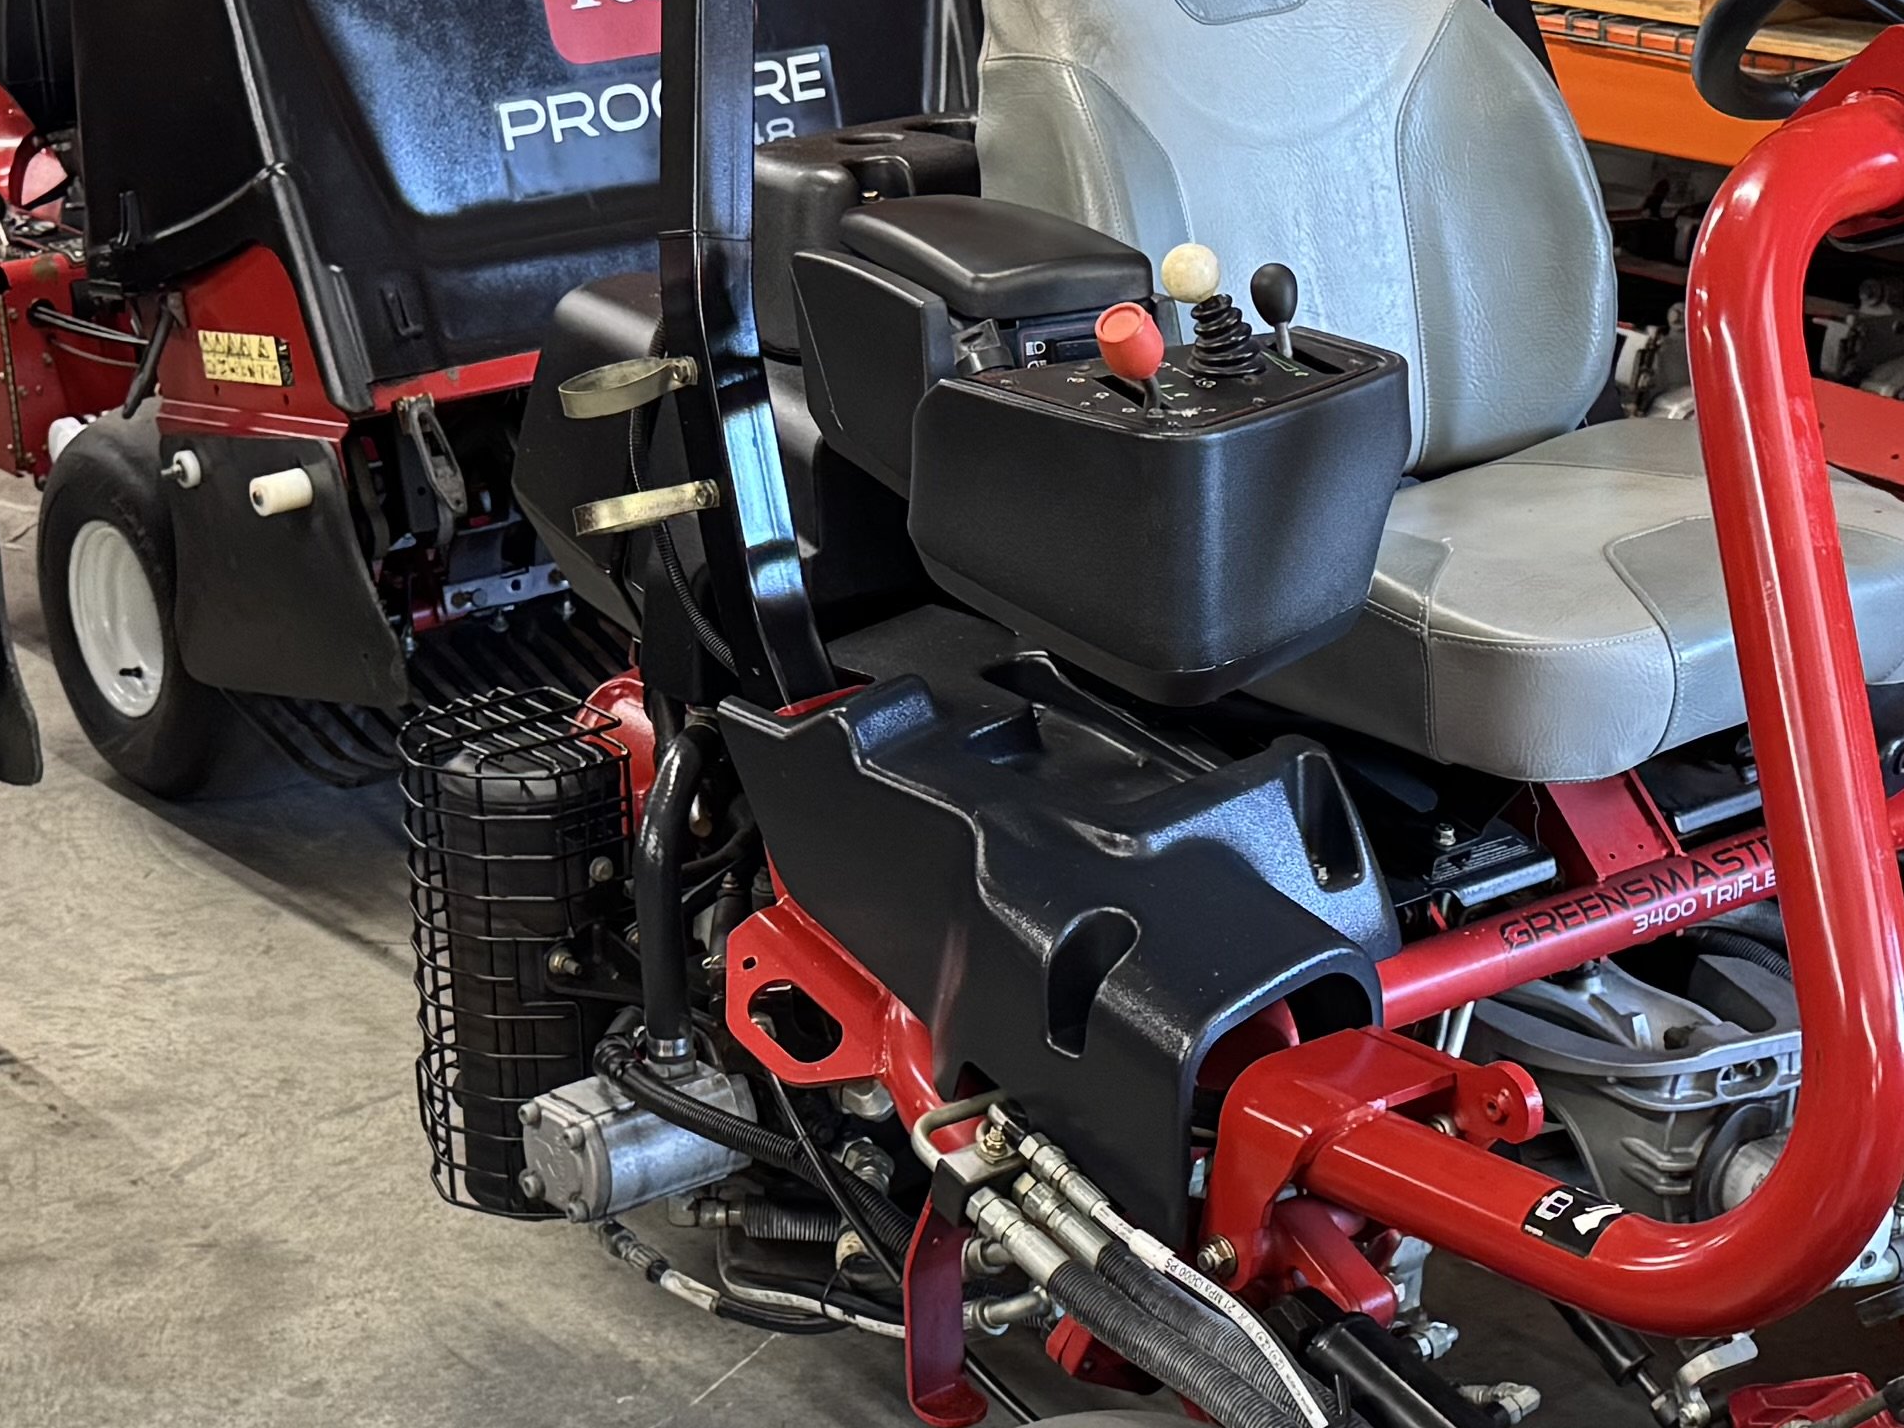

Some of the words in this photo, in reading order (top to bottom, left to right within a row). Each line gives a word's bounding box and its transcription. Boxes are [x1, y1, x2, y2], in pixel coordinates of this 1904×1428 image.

[497, 51, 826, 152] PRORE
[1632, 898, 1697, 935] 3400
[1700, 868, 1777, 909] TRIFLE
[1165, 1257, 1179, 1273] PS
